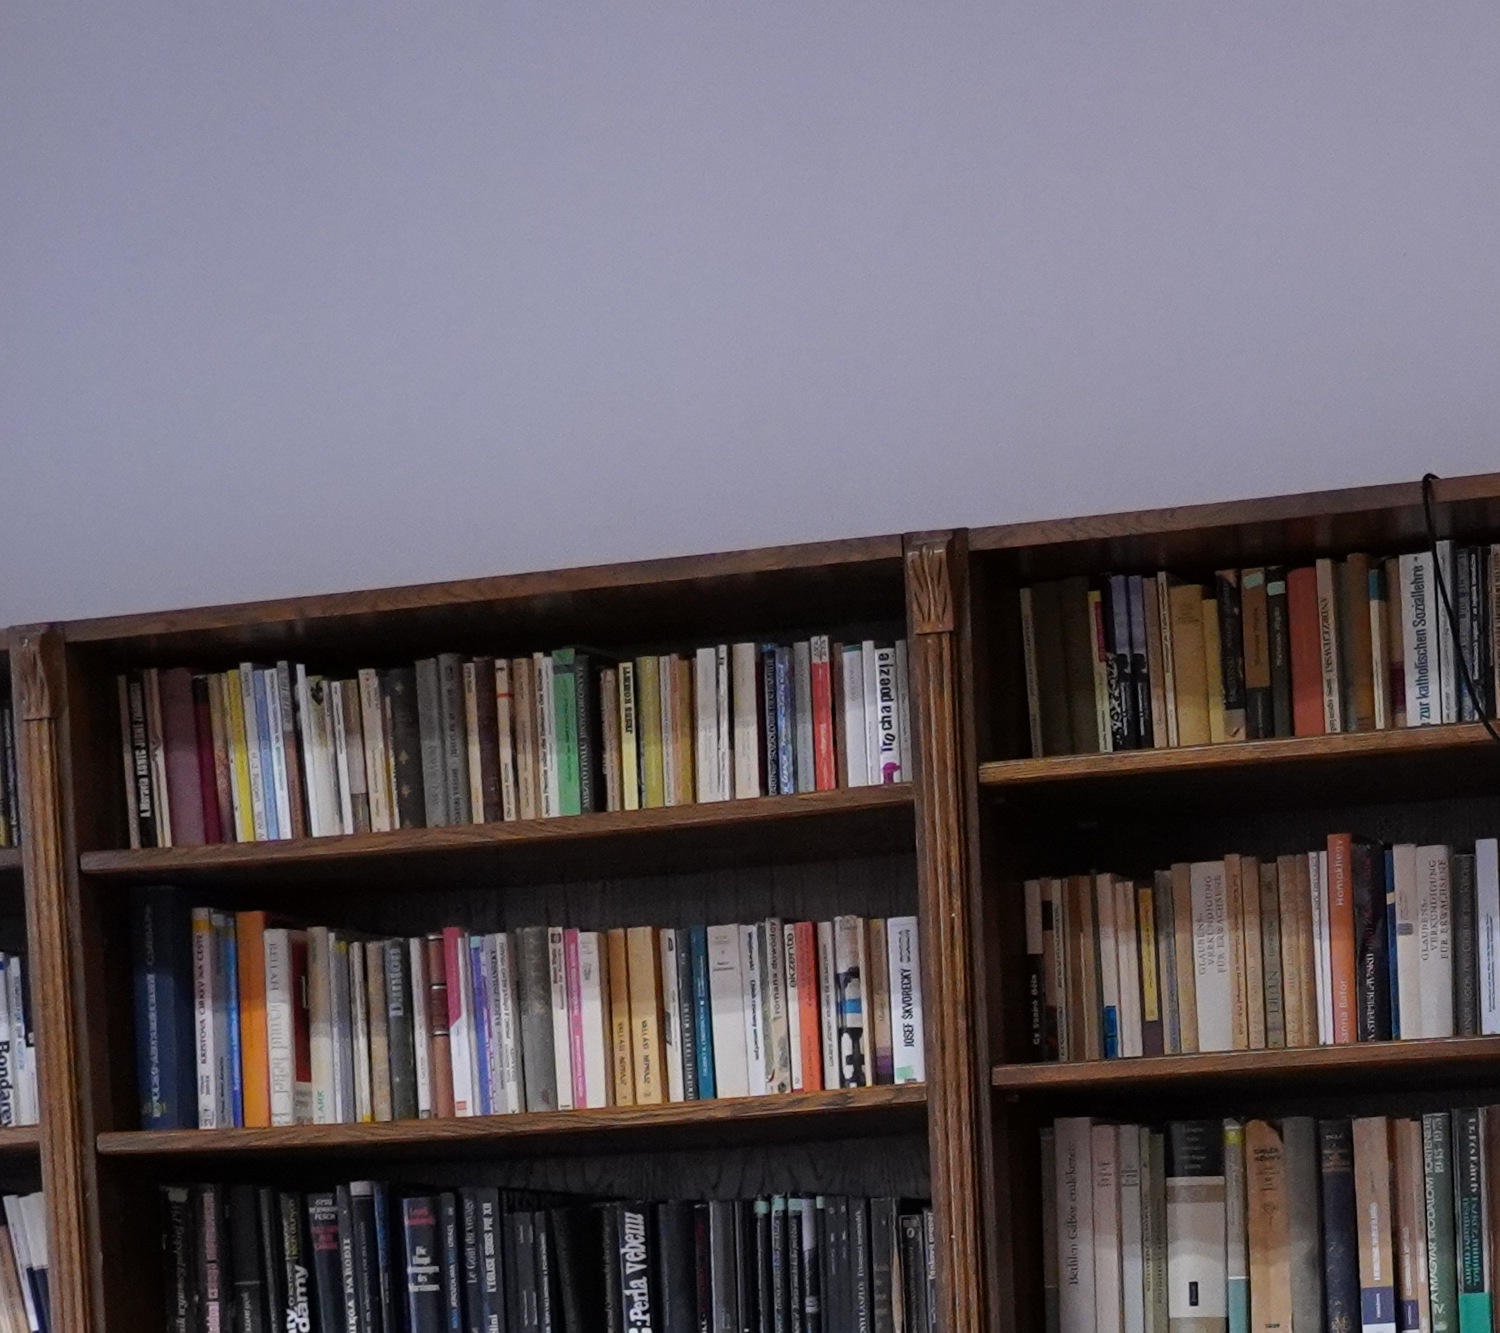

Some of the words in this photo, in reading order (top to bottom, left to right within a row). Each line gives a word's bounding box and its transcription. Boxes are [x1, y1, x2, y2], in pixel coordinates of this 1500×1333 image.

[1411, 565, 1426, 627] Soziallehre
[1413, 629, 1429, 699] katholischen
[1417, 701, 1431, 720] zur
[1428, 860, 1437, 950] VERKÜNDIGUNG
[1438, 860, 1448, 934] ERWACHSENE
[389, 948, 403, 1018] Danton
[1439, 939, 1448, 960] FÜR
[901, 1023, 914, 1047] JOSEF
[293, 1263, 311, 1333] dámy
